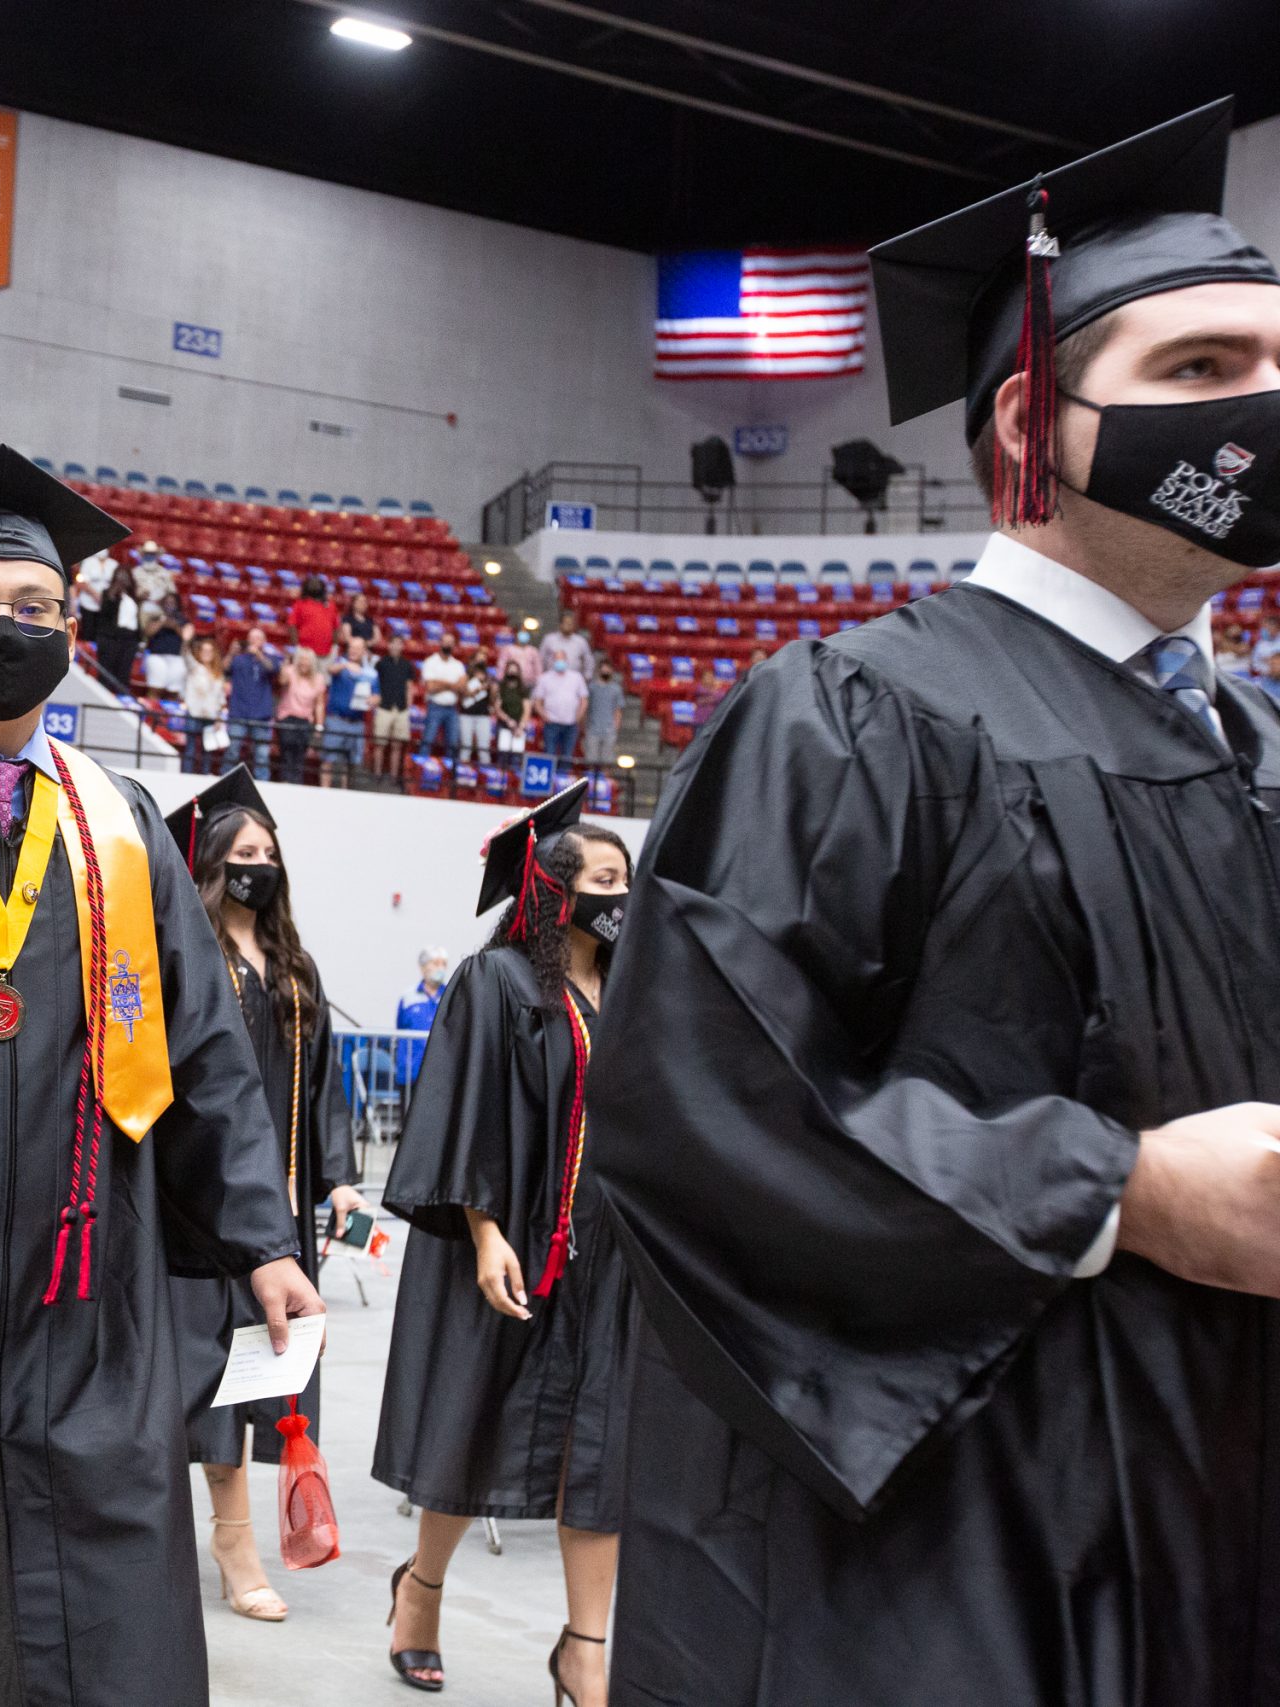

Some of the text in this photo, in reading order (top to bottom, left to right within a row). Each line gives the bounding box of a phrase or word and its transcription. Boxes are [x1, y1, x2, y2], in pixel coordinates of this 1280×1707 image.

[1158, 477, 1239, 529] STATE
[1169, 460, 1252, 515] POLK
[1150, 493, 1230, 539] COLLEGE
[45, 712, 74, 735] 33
[526, 764, 549, 786] 34
